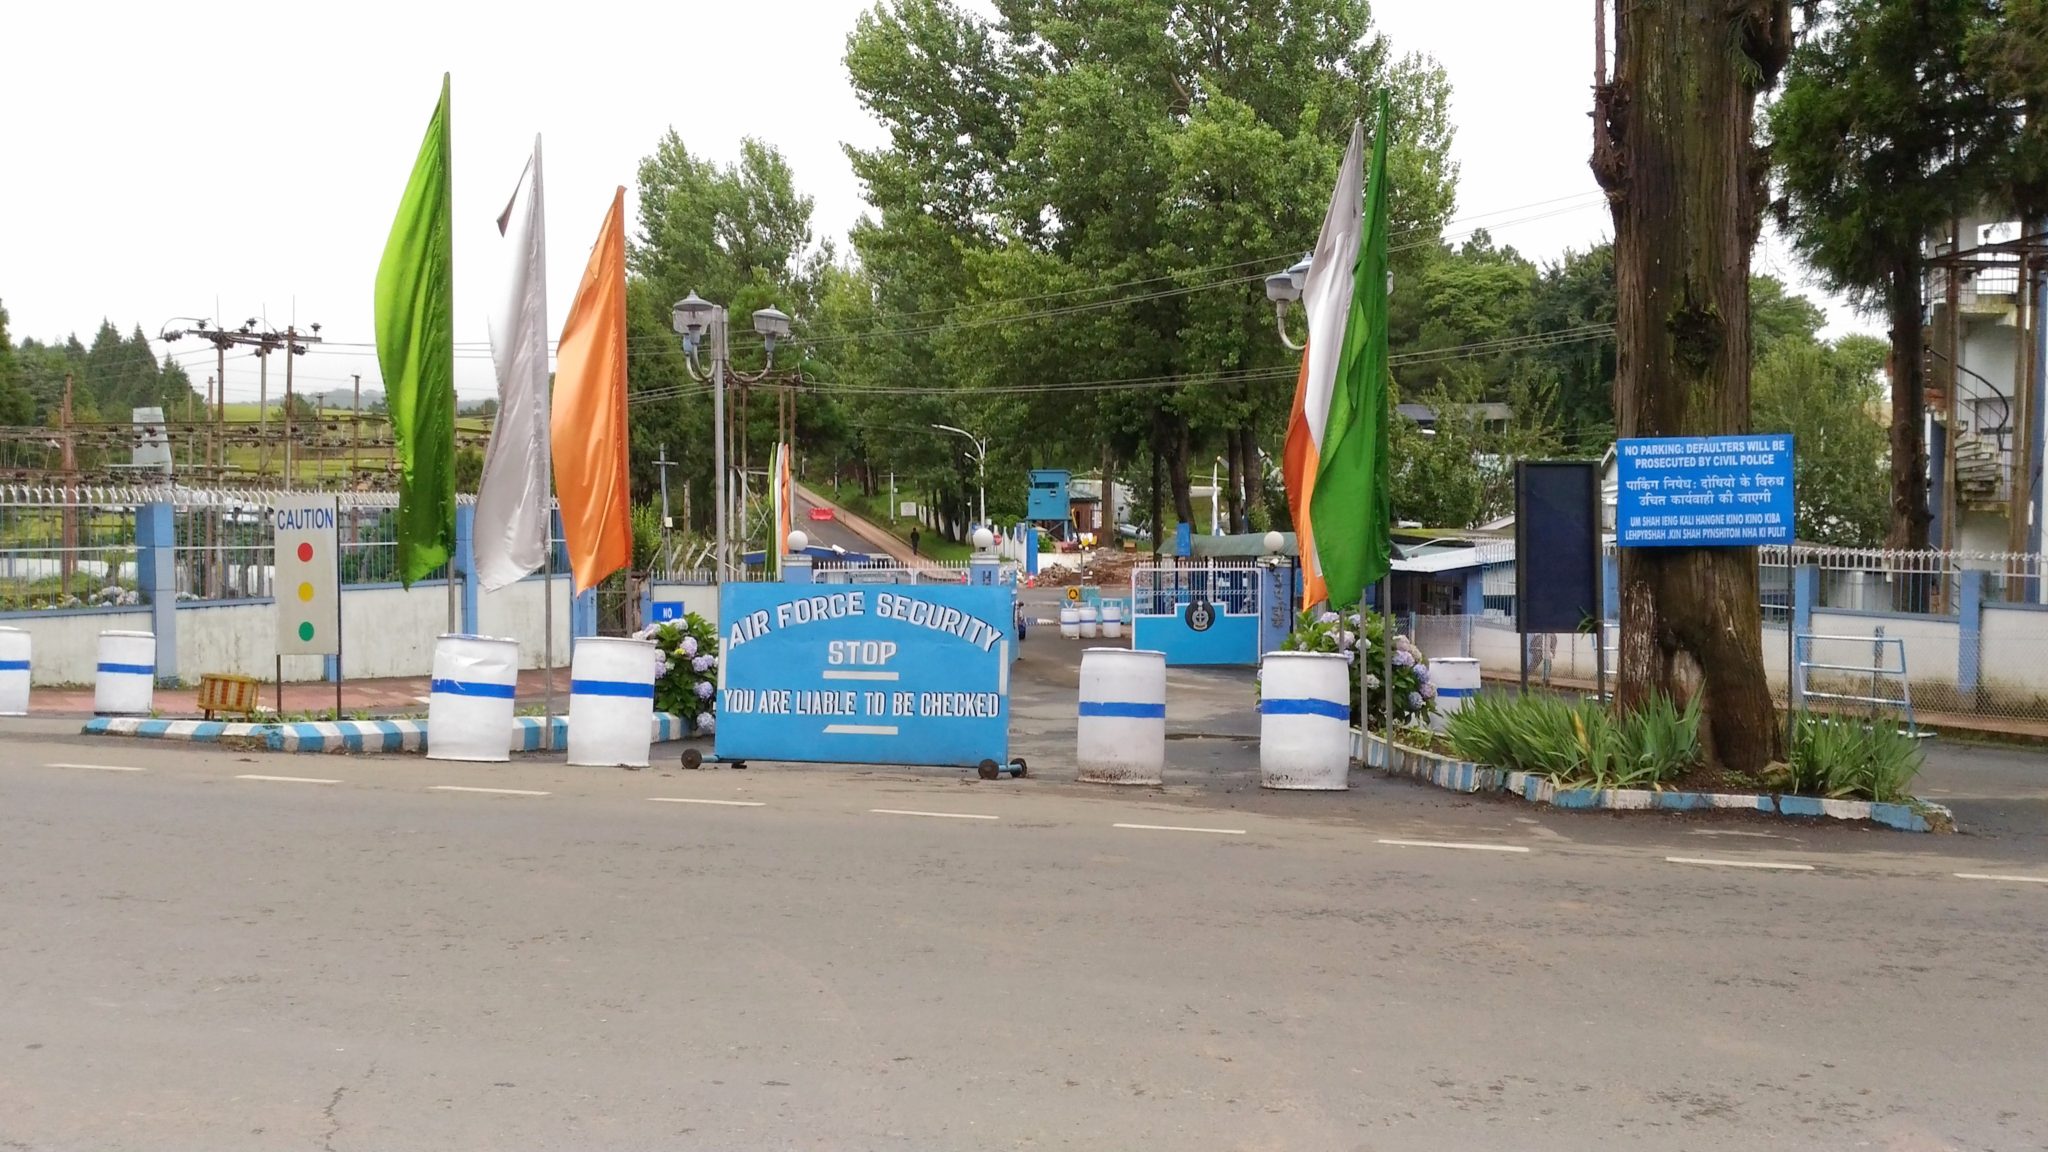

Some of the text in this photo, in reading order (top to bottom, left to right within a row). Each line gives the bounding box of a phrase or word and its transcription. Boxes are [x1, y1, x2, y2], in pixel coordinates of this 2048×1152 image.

[1624, 440, 1785, 456] NO PARKING: DEFAULTERS WILL BE
[1635, 454, 1775, 469] PROSECUTED BY CIVIL POLICE
[1739, 473, 1752, 487] के
[1638, 488, 1772, 506] उचित कार्यवाही की जाएगी
[277, 508, 334, 530] CAUTION
[1642, 516, 1661, 527] SHAH
[1679, 515, 1695, 526] KALI
[1695, 514, 1725, 526] HANGNE
[1764, 512, 1781, 524] KIBA
[1682, 528, 1701, 540] SHAH
[1742, 527, 1758, 538] NHA
[1759, 527, 1767, 538] KI
[1767, 526, 1787, 538] PULIT
[729, 591, 1003, 653] AIR FORCE SECURITY
[827, 640, 898, 665] STOP
[723, 688, 1000, 718] YOU ARE LIABLE TO BE CHECKED
